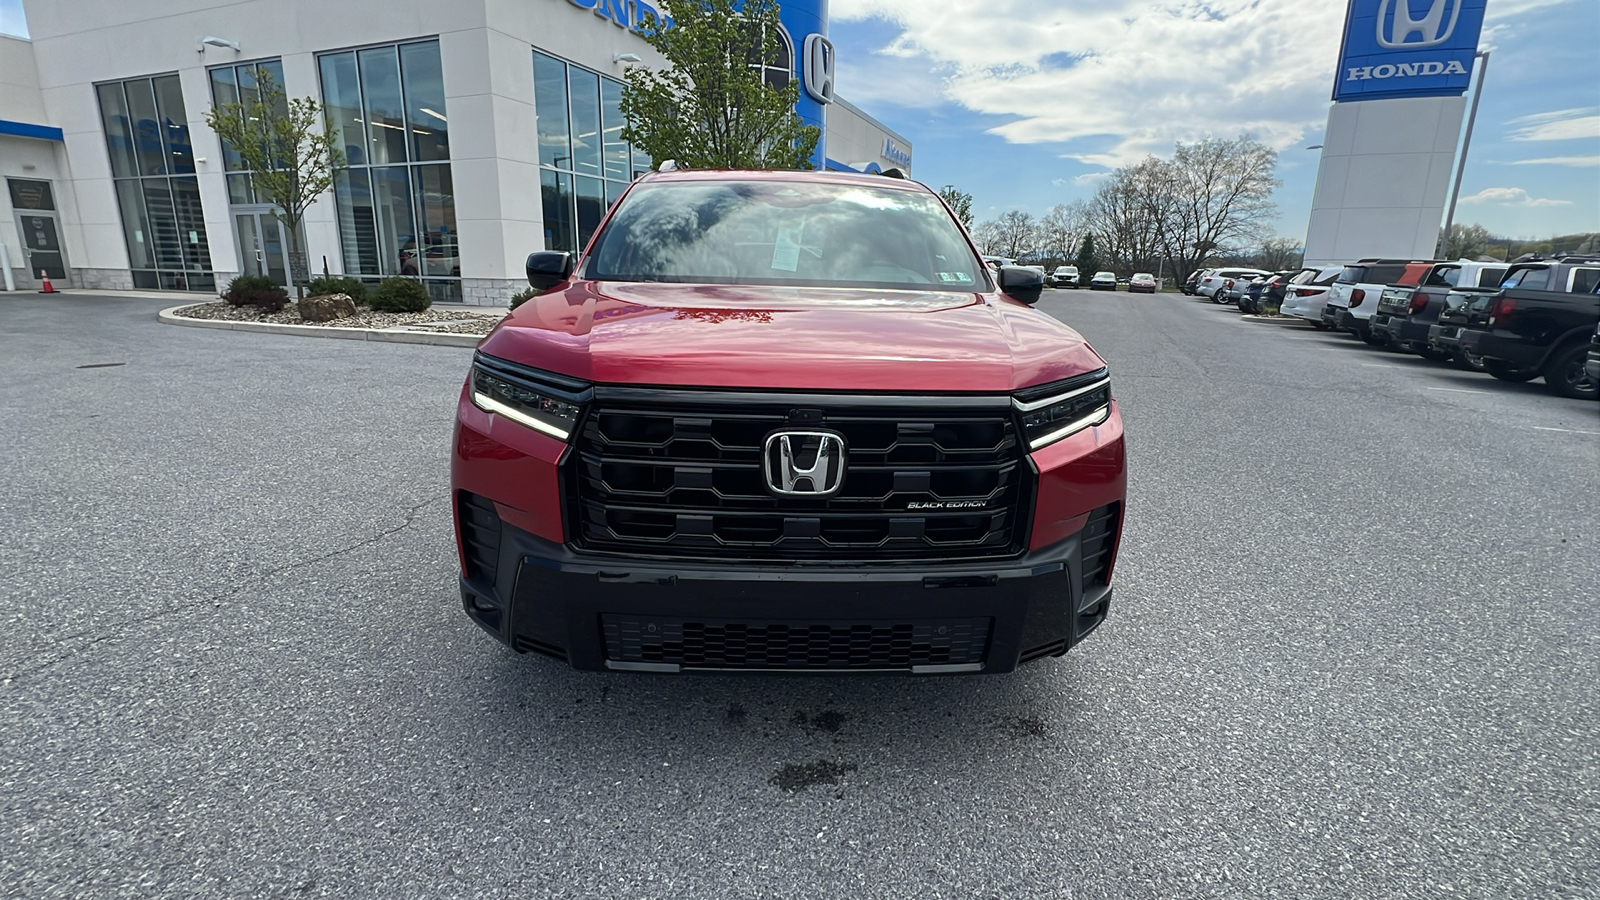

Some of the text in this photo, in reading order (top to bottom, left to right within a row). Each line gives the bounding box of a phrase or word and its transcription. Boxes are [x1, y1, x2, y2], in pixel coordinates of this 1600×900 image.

[1346, 60, 1467, 81] HONDA
[907, 500, 987, 509] BLACK EDITION
